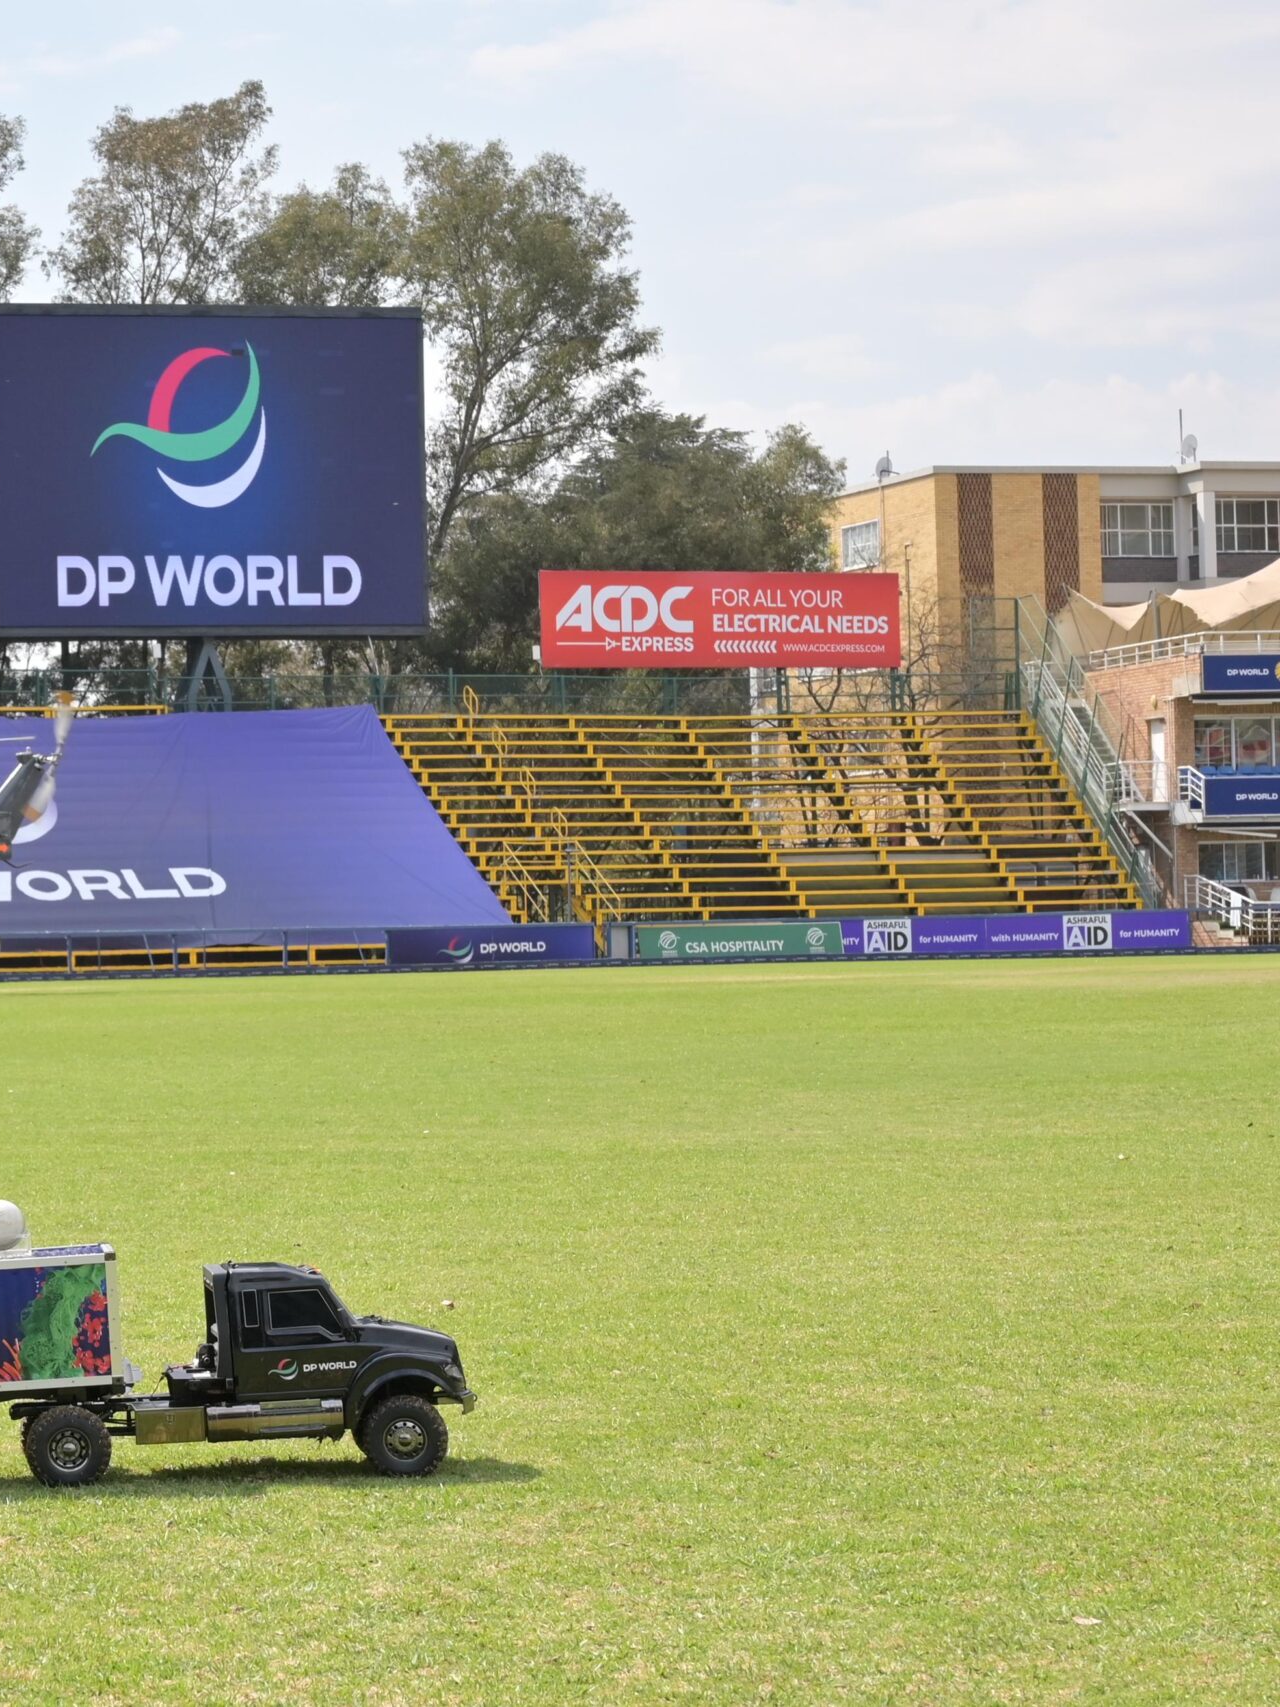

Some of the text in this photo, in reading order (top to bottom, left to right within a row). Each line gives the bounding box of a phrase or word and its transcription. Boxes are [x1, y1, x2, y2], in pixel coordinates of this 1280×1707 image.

[57, 555, 362, 607] DP WORLD
[712, 588, 843, 608] FOR ALL YOUR
[556, 585, 694, 633] ACDC
[712, 613, 889, 634] ELECTRICAL NEEDS
[621, 636, 694, 652] EXPRESS
[782, 643, 886, 653] WWW.ACDCEXPRESS.COM
[1226, 668, 1270, 676] DP WORLD
[1235, 793, 1248, 801] DP
[867, 921, 908, 929] ASHRAFUL
[1066, 916, 1108, 924] ASHRAFUL
[919, 934, 978, 944] for HUMANITY
[991, 932, 1059, 942] with HUMANITY
[1066, 926, 1109, 947] AID
[1120, 928, 1180, 938] for HUMANITY
[480, 941, 546, 954] DP WORLD
[685, 942, 709, 954] CSA
[710, 940, 785, 953] HOSPITALITY
[867, 931, 908, 952] AID
[303, 1361, 357, 1372] DP WORLD
